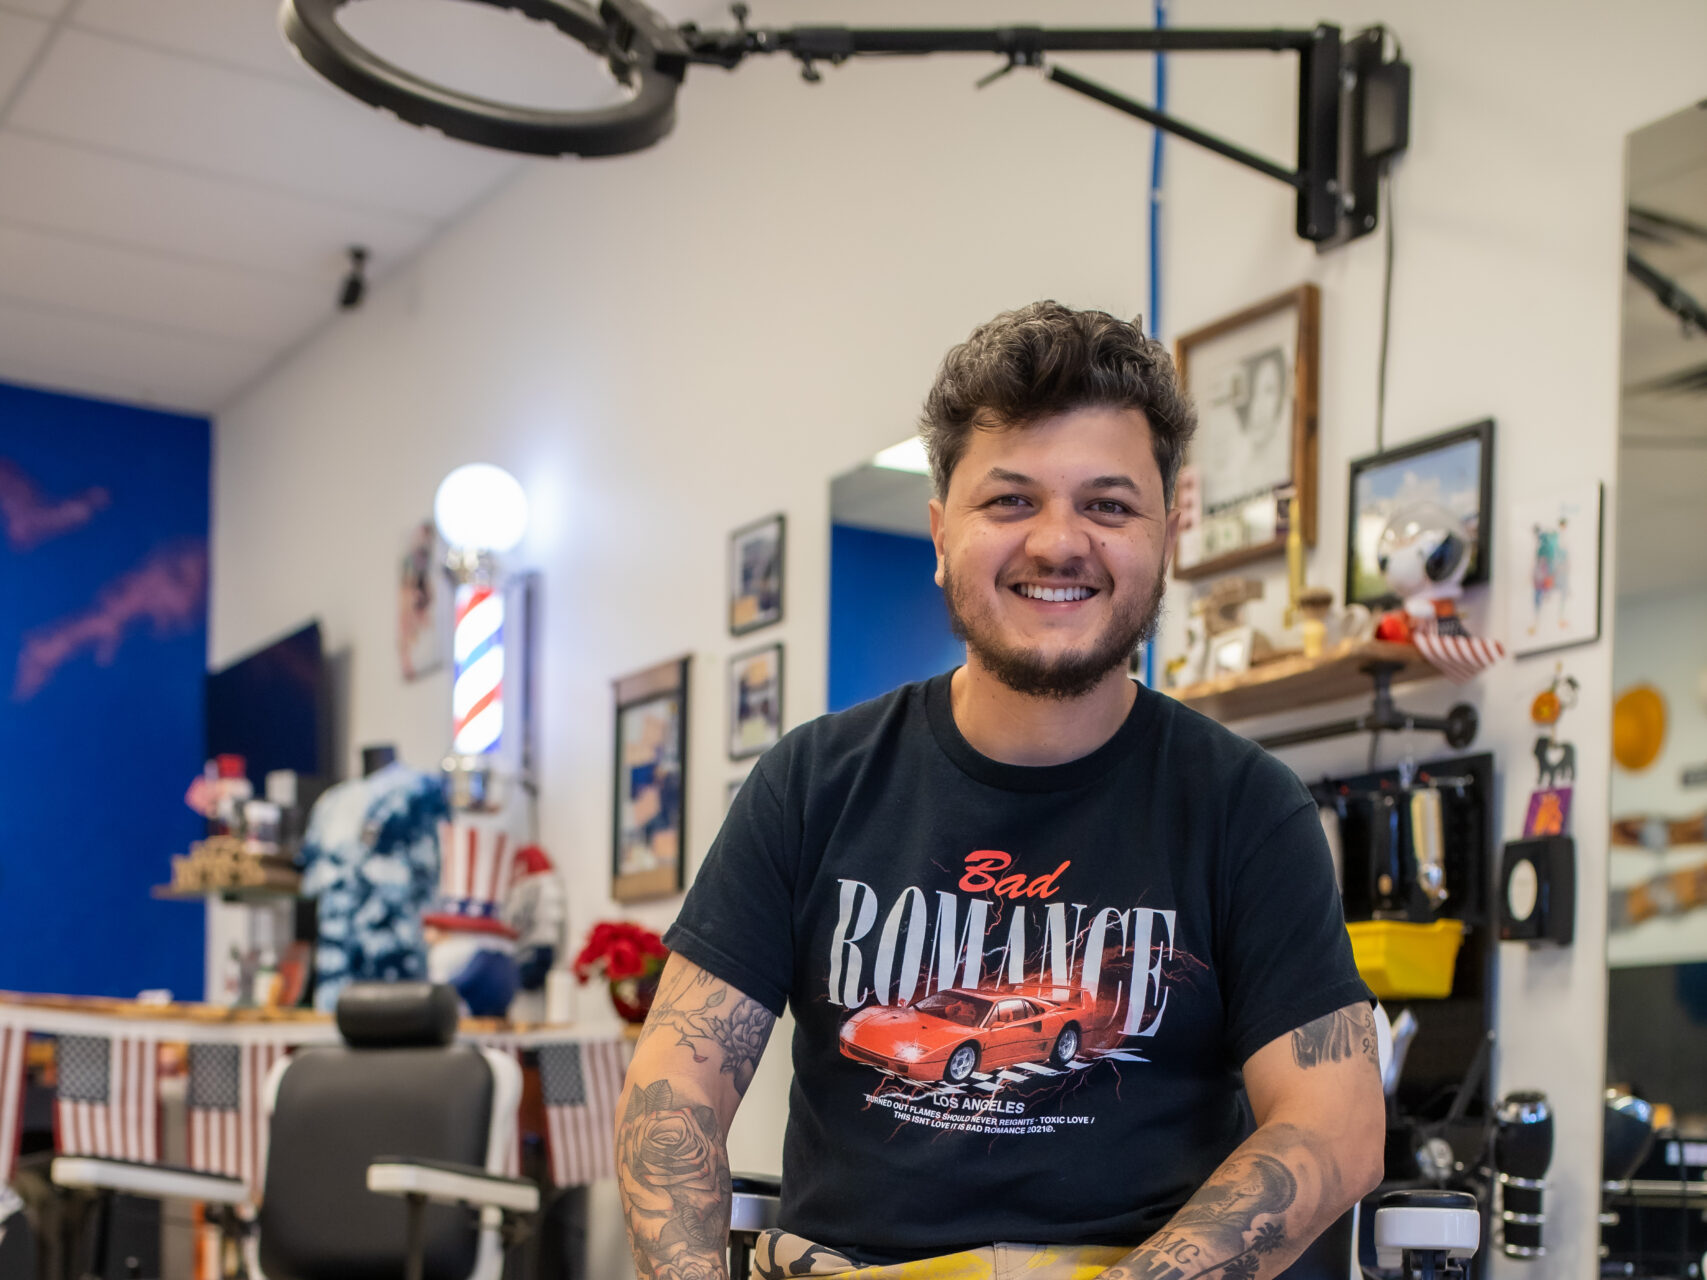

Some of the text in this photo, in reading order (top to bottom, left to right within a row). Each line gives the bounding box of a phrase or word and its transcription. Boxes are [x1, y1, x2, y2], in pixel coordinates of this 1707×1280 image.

[959, 850, 1071, 899] Bad
[827, 878, 1177, 1038] ROMANCE
[865, 1094, 892, 1108] BURNED
[892, 1101, 910, 1112] OUT
[909, 1106, 941, 1119] FLAMES
[941, 1112, 970, 1123] SHOULD
[970, 1115, 998, 1126] NEVER
[998, 1117, 1035, 1126] REIGNITE
[1039, 1116, 1066, 1124] TOXIC
[1067, 1116, 1089, 1124] LOVE
[933, 1093, 1025, 1114] LOS ANGELES
[893, 1110, 911, 1121] THIS
[911, 1115, 931, 1126] ISNT
[930, 1120, 950, 1130] LOVE
[957, 1123, 966, 1131] IS
[965, 1123, 983, 1133] BAD
[983, 1126, 1026, 1135] ROMANCE
